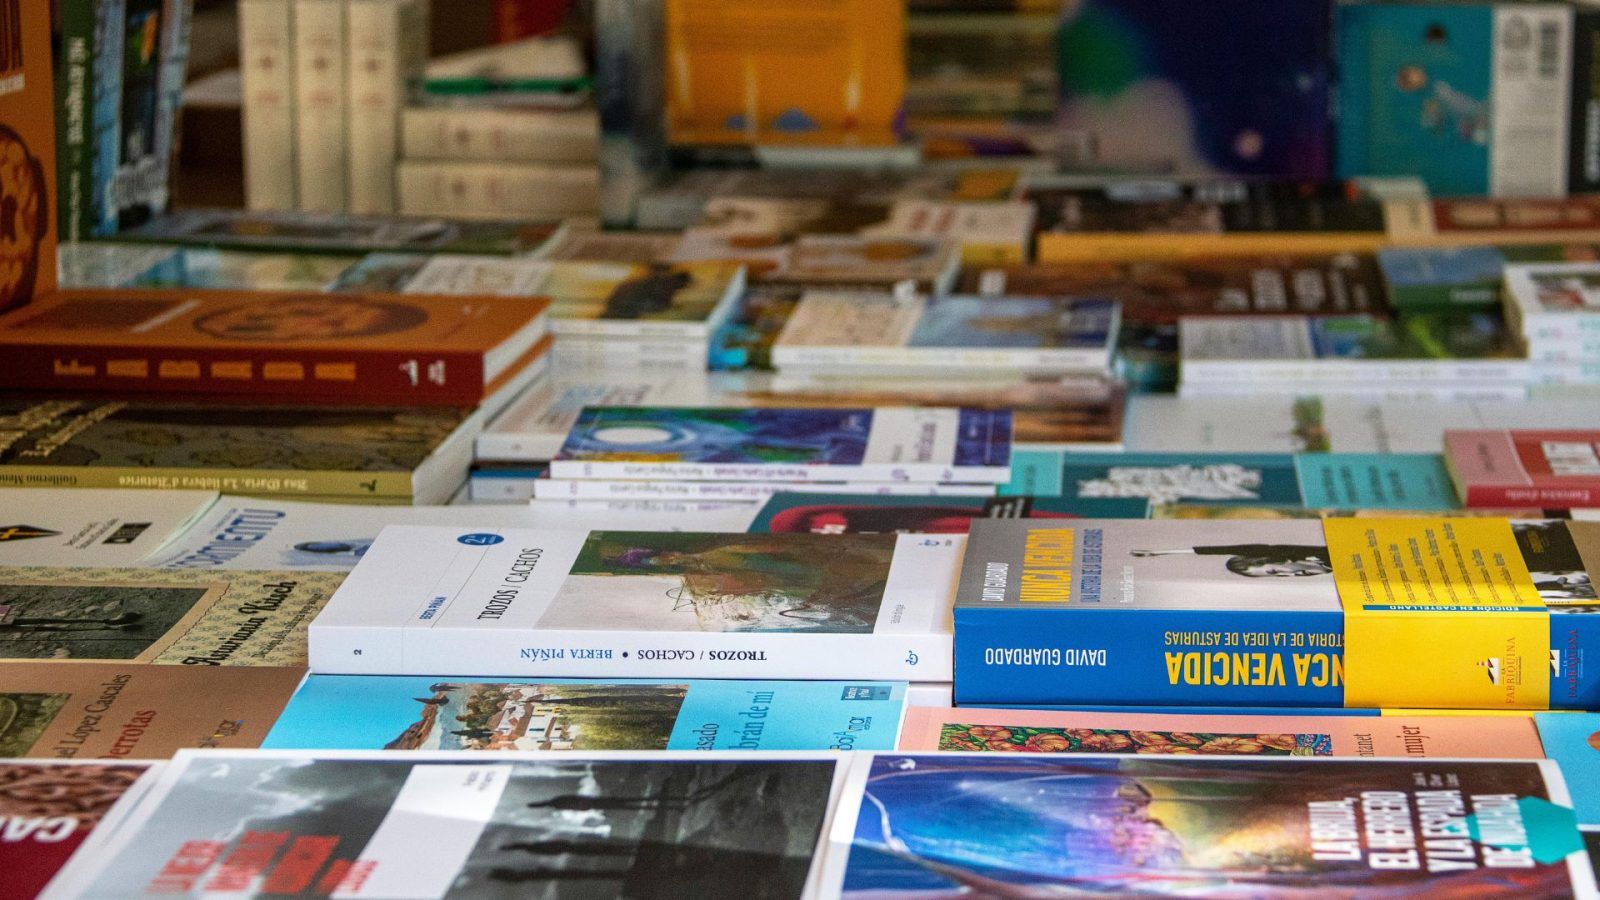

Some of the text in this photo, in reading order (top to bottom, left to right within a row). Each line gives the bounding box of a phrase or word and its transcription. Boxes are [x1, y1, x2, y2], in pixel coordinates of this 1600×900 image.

[1019, 528, 1076, 602] NUNCA VENCIDA
[477, 589, 519, 620] TROZOS
[505, 548, 544, 583] CACHOS
[982, 562, 1010, 602] DAVID GUARDADO
[181, 616, 268, 666] Asturiania
[238, 580, 298, 612] Kitsch
[1164, 631, 1344, 648] TORIA DE LA IDEA DE ASTURIAS
[353, 648, 362, 656] 2
[520, 648, 564, 662] PIÑÁN
[570, 648, 613, 660] BERTA
[637, 649, 695, 660] CACHOS
[709, 650, 767, 661] TROZOS
[985, 647, 1107, 666] DAVID GUARDADO
[1568, 629, 1579, 699] FABRIQUINA
[1164, 651, 1287, 687] VENCIDA
[1505, 636, 1516, 704] FABRIQUINA
[746, 690, 775, 705] mí
[66, 713, 101, 747] López
[85, 673, 132, 713] Cascales
[739, 703, 769, 721] de
[1395, 725, 1430, 754] mujer
[1414, 789, 1471, 838] ESPADA
[0, 815, 80, 844] CA
[1360, 790, 1421, 870] EL HERRERO
[1311, 839, 1362, 861] LA
[1423, 838, 1477, 859] LA
[1482, 845, 1537, 869] DE
[1426, 858, 1478, 873] Y
